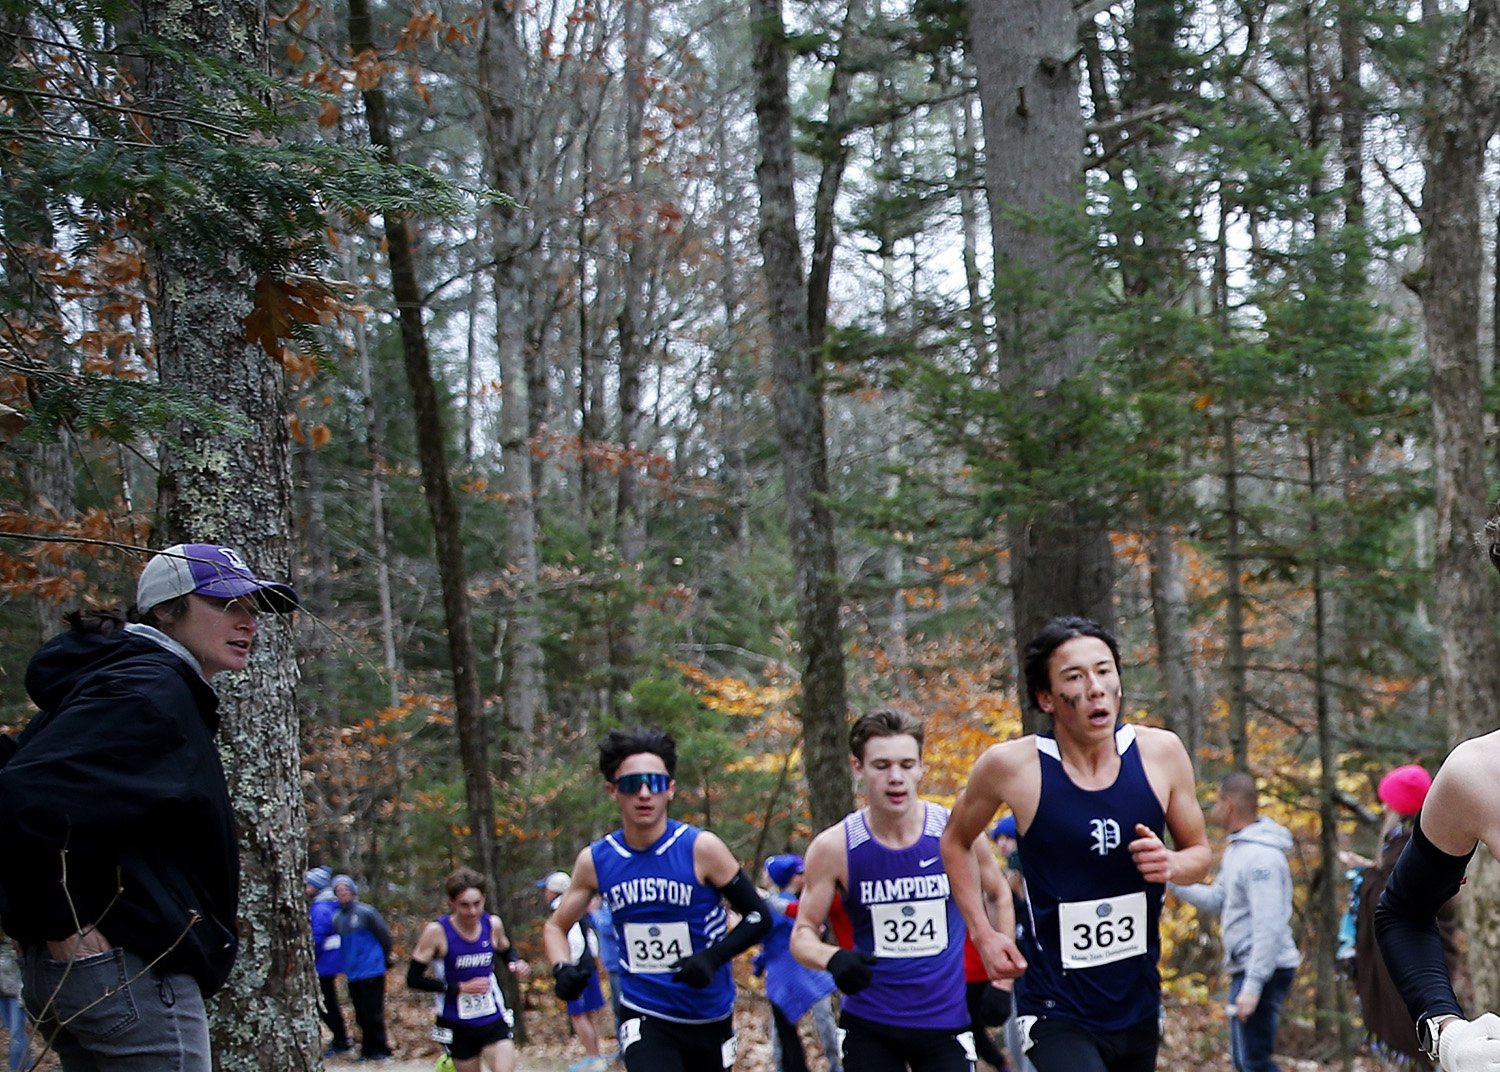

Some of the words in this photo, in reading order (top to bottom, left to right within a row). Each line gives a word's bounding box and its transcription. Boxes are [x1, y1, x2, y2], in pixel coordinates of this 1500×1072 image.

[860, 873, 950, 904] HAMPDEN
[883, 919, 935, 943] 324
[1073, 916, 1134, 950] 363
[634, 939, 683, 960] 334
